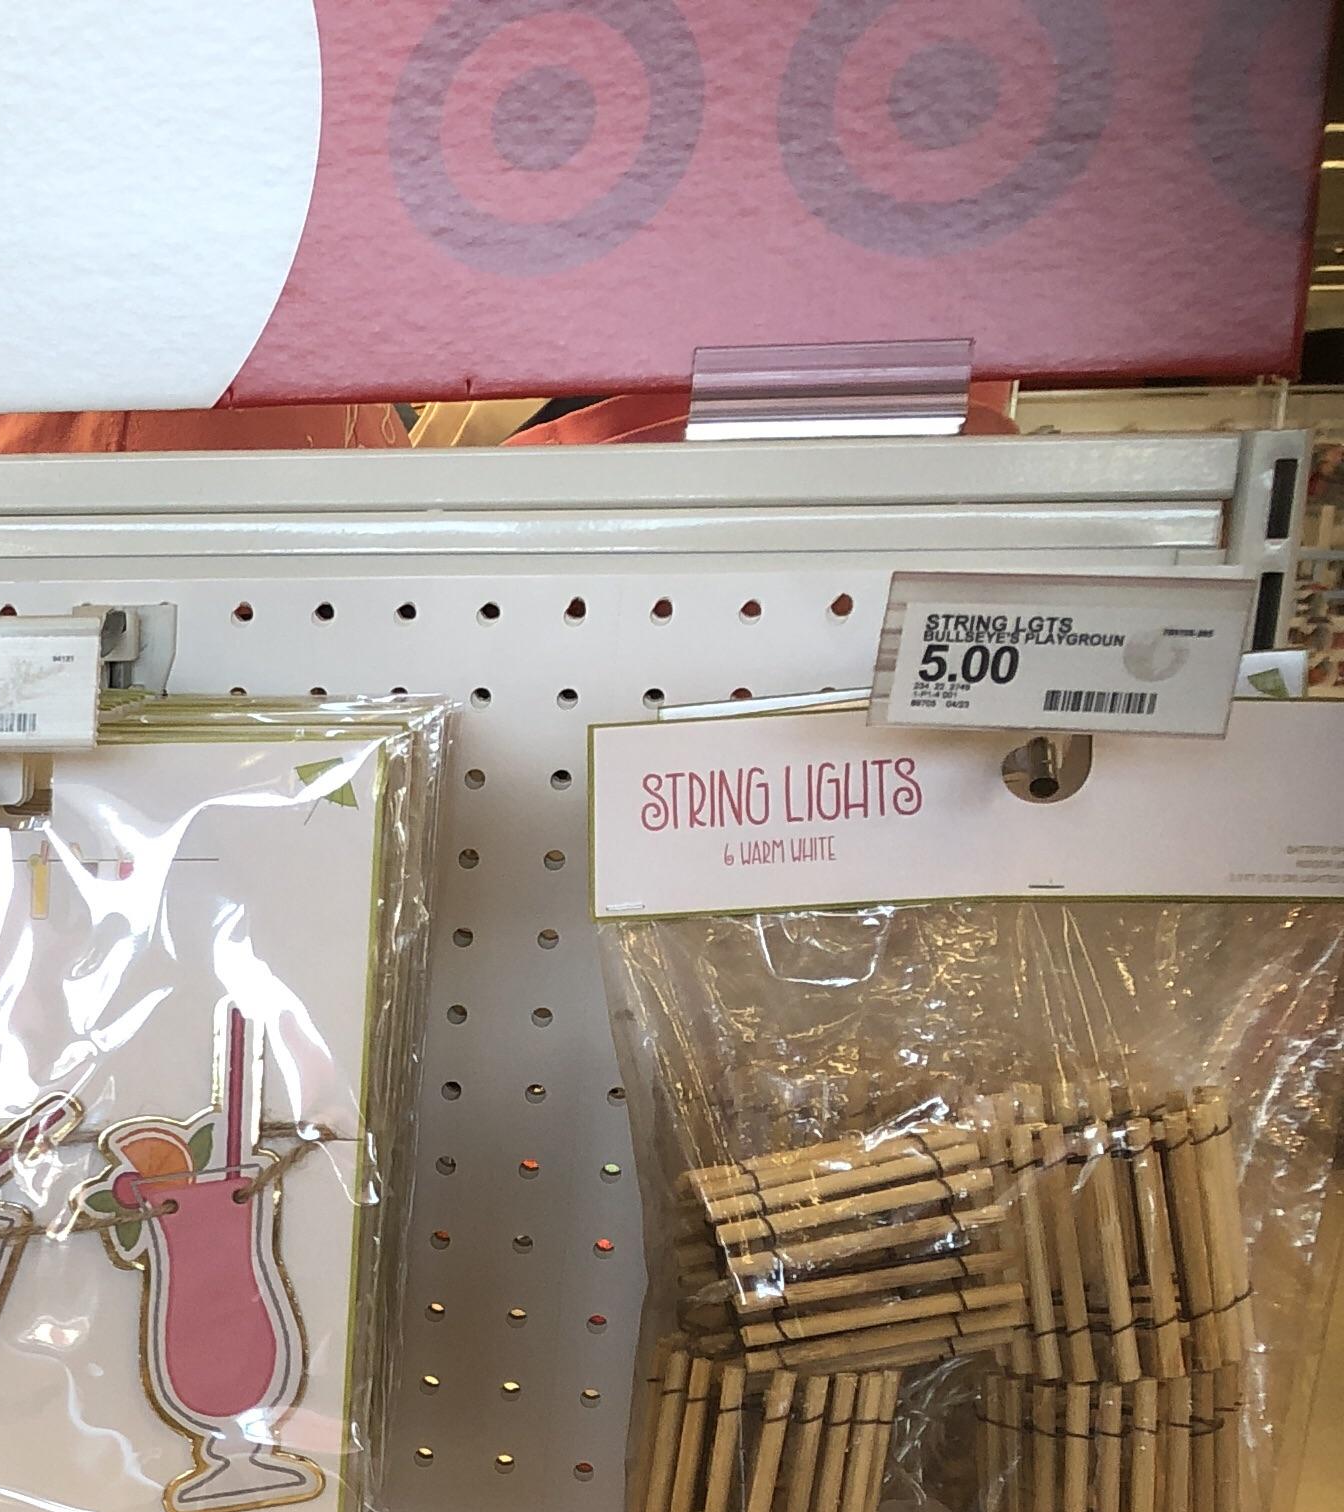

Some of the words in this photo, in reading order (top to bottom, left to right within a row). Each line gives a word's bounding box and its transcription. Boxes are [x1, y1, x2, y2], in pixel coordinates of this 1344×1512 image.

[923, 630, 1019, 645] BULLSEYE'S
[1023, 631, 1125, 647] PLAYGROUN
[925, 613, 1007, 634] STRING
[1014, 615, 1074, 634] LGTS
[917, 644, 1020, 685] 5.00
[641, 766, 770, 832] STRING
[784, 757, 923, 823] LIGHTS
[723, 842, 735, 866] 6
[740, 839, 786, 866] WARM
[789, 835, 838, 863] WHITE
